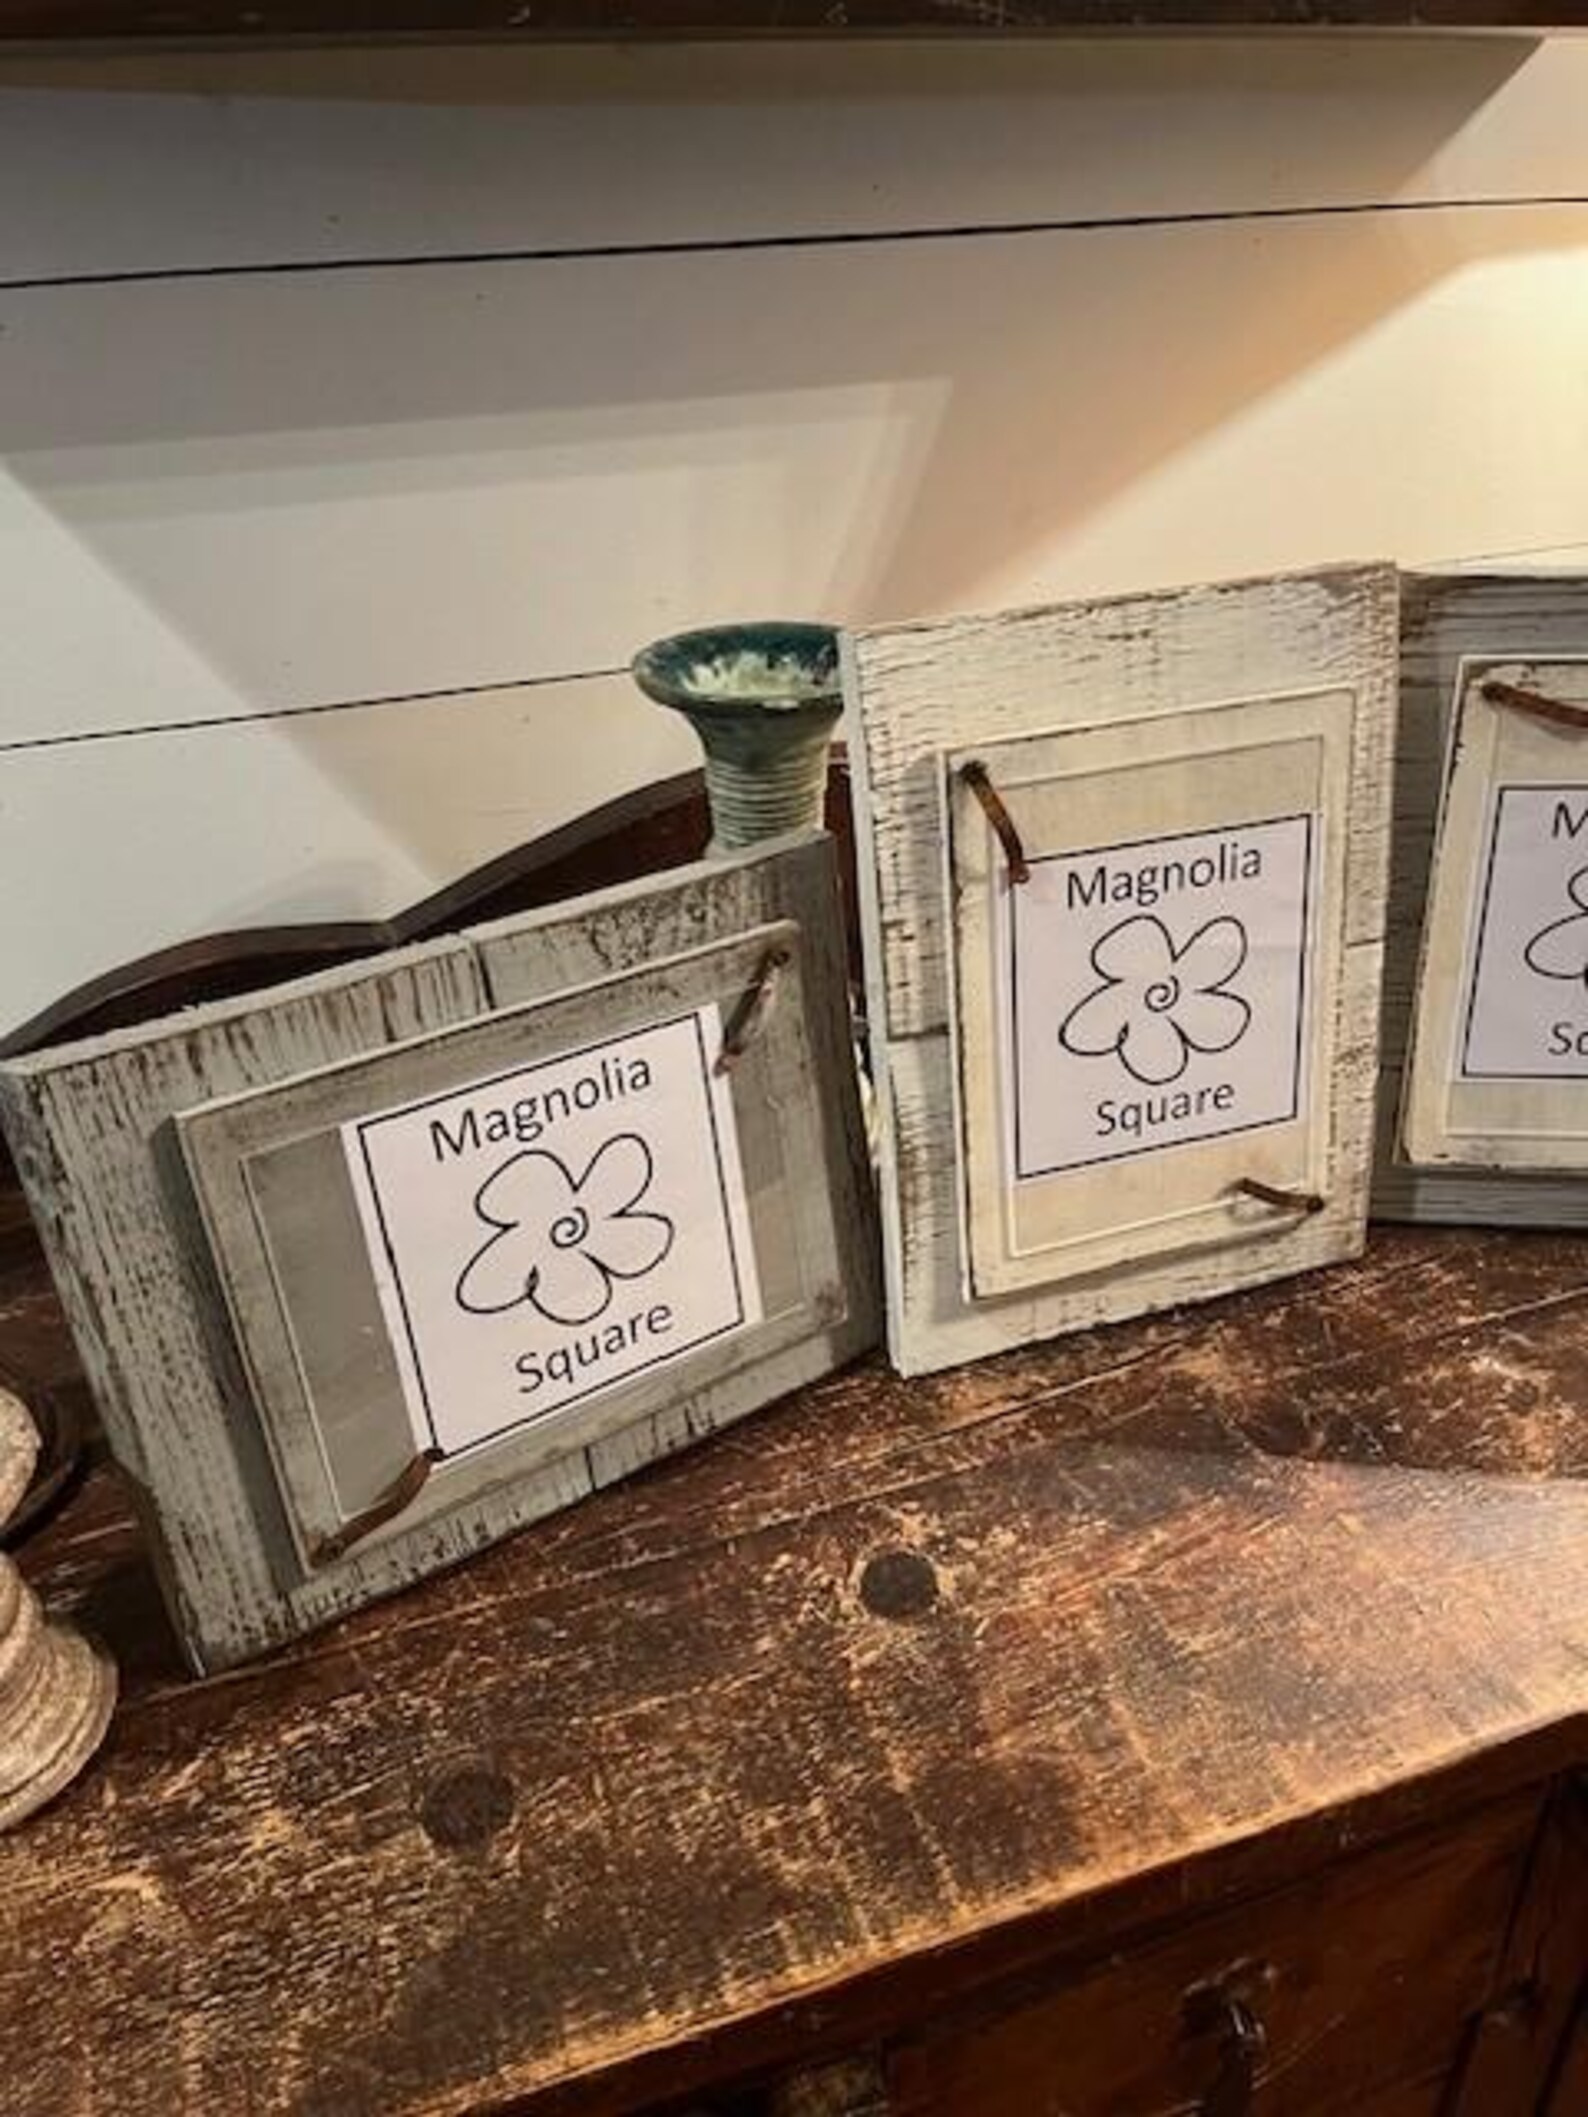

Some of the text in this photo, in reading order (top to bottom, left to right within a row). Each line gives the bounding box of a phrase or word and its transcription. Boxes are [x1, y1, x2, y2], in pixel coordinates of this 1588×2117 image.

[1067, 843, 1262, 909] Magnolia
[430, 1056, 652, 1163] Magnolia
[1096, 1082, 1235, 1137] Square
[515, 1303, 673, 1394] Square
